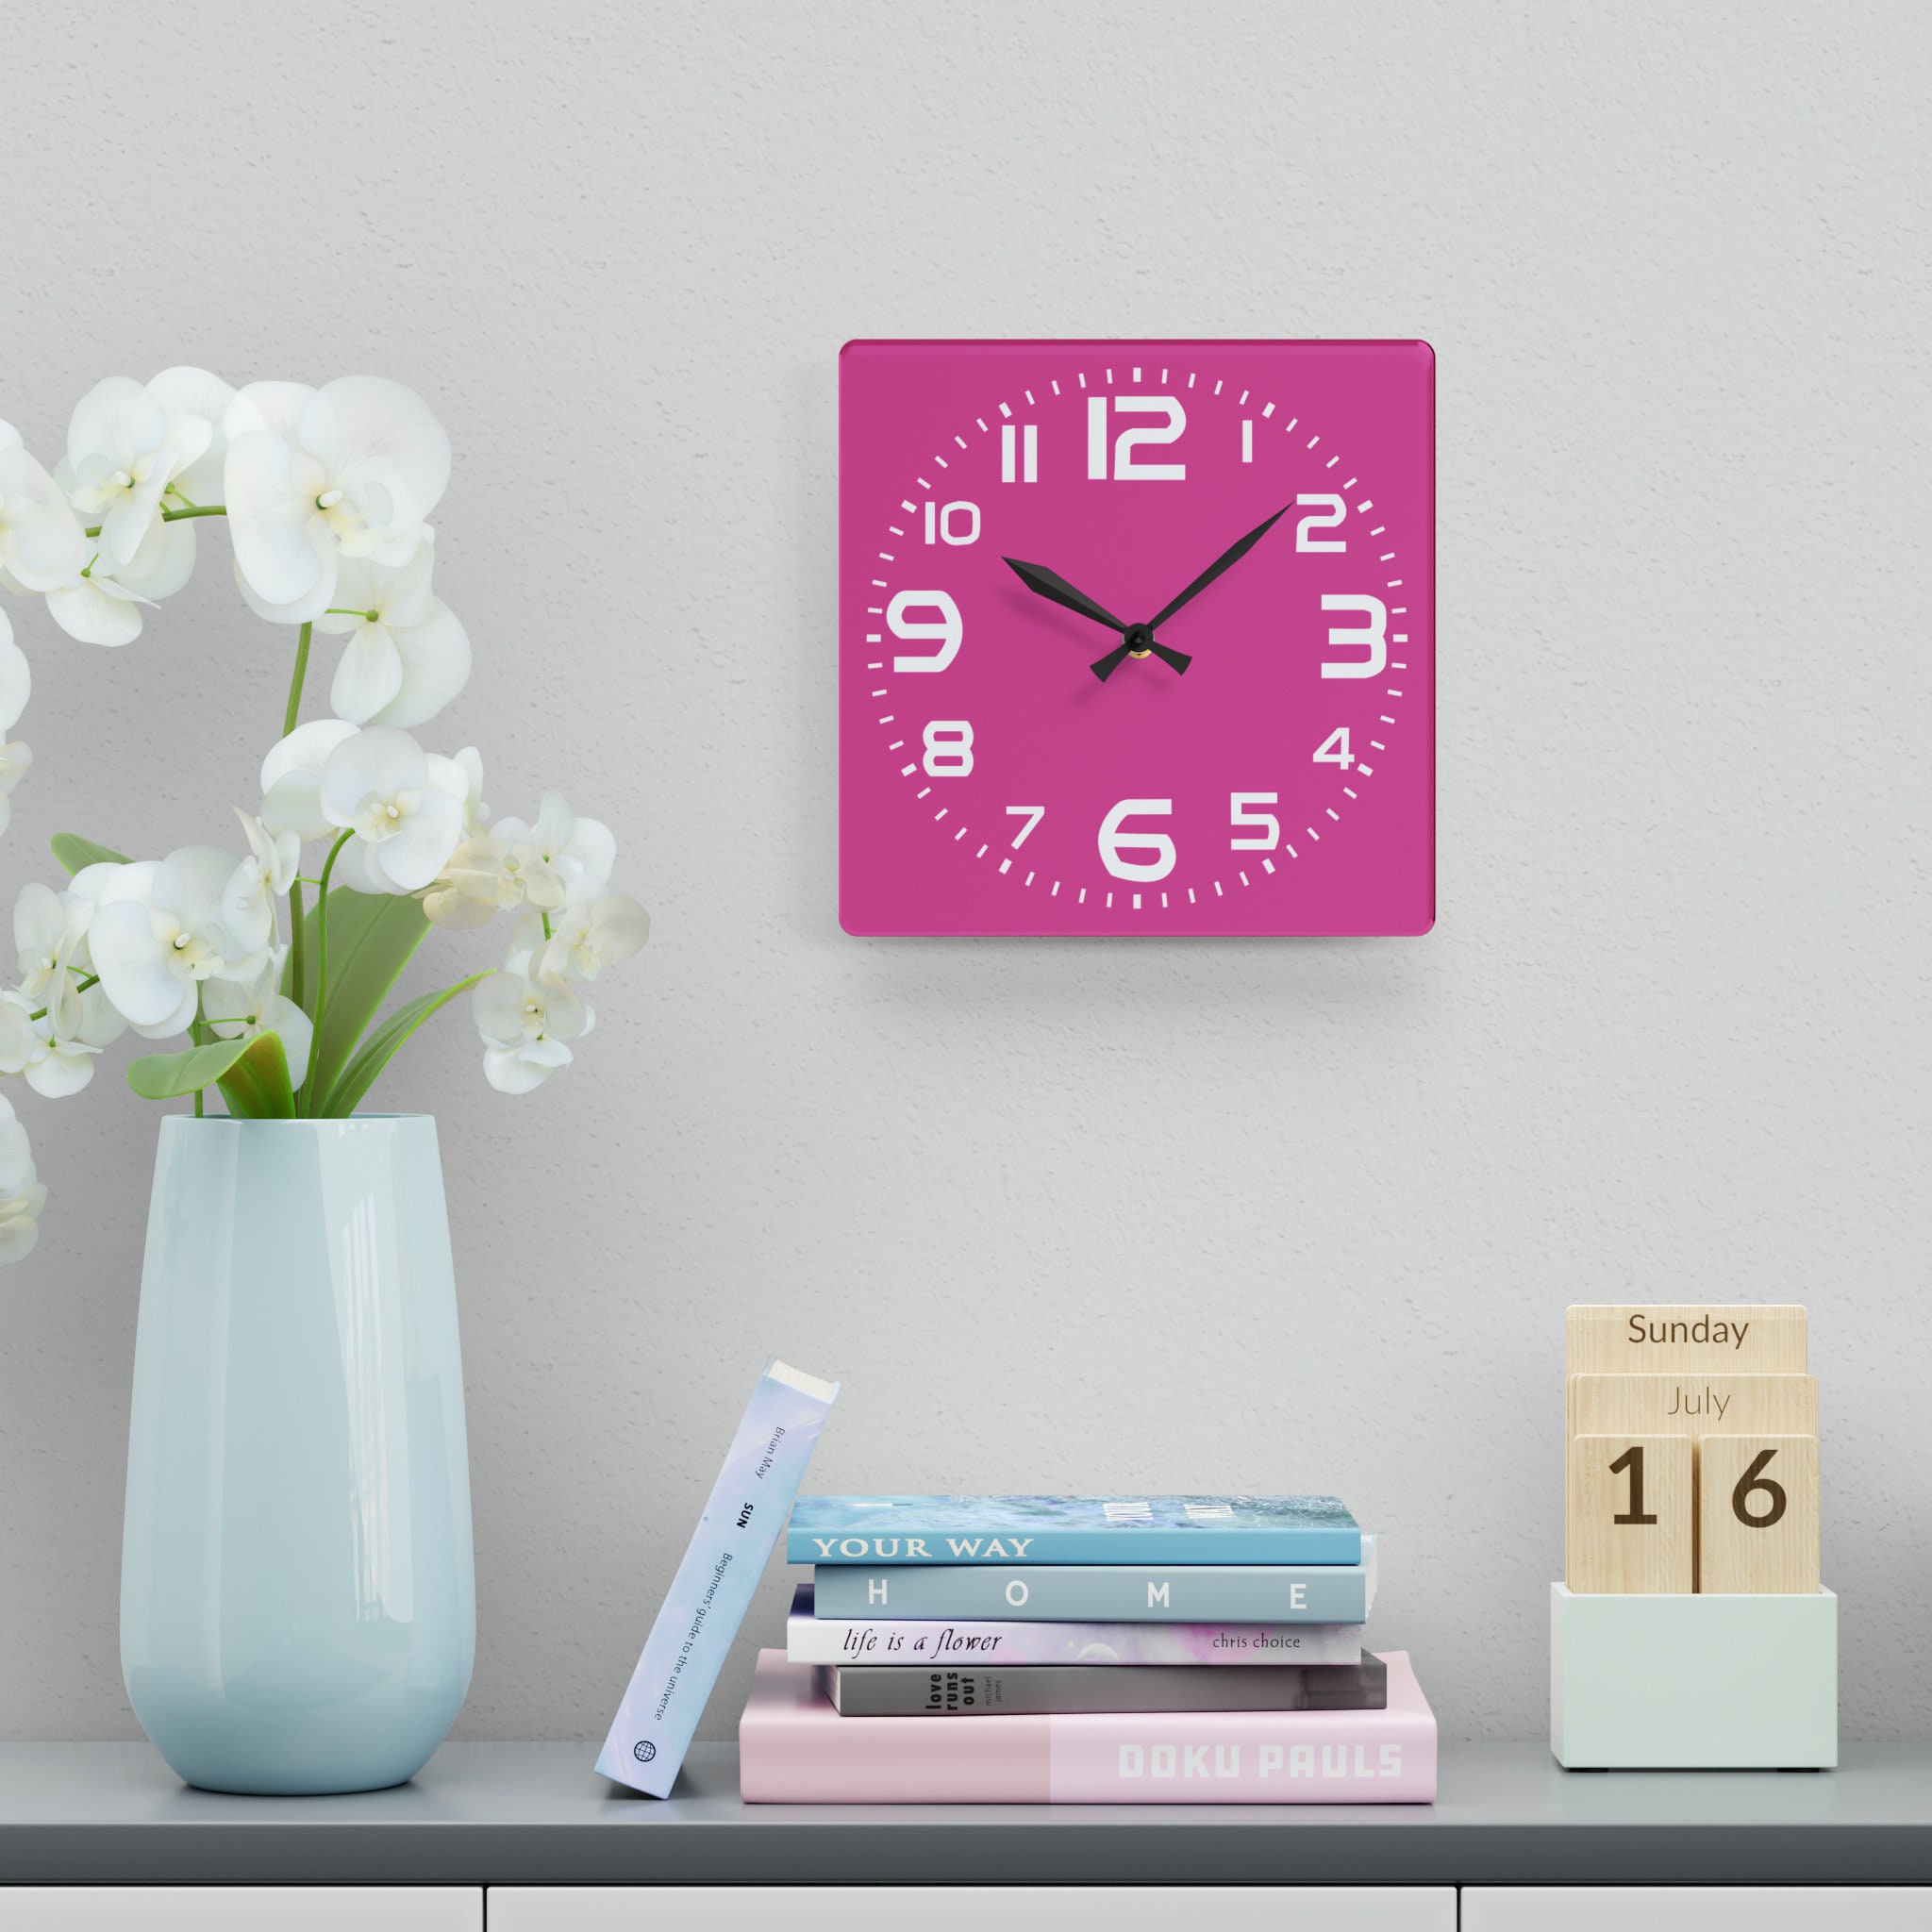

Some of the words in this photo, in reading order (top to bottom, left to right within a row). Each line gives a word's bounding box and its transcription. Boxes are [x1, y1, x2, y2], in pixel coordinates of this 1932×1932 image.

[1001, 425, 1038, 483] 11
[1087, 395, 1187, 481] 12
[1242, 420, 1253, 463] 1
[924, 500, 981, 546] 10
[1295, 493, 1348, 553] 2
[886, 590, 963, 673] 9
[1321, 594, 1388, 678] 3
[922, 720, 974, 777] 8
[1312, 726, 1356, 771] 4
[1006, 806, 1045, 850] 7
[1230, 791, 1280, 851] 5
[1097, 798, 1176, 883] 6
[1627, 1313, 1750, 1350] Sunday
[1667, 1386, 1731, 1422] July
[767, 1426, 786, 1455] Brian
[755, 1457, 774, 1479] May
[737, 1502, 754, 1528] SUN
[811, 1538, 933, 1557] YOUR
[945, 1538, 1034, 1557] WAY
[688, 1608, 707, 1640] guide
[1212, 1633, 1247, 1648] chris
[1253, 1633, 1301, 1648] choice
[682, 1641, 693, 1653] to
[843, 1628, 877, 1659] life
[887, 1632, 904, 1651] is
[913, 1636, 928, 1651] a
[929, 1628, 1003, 1659] flower
[673, 1656, 688, 1674] the
[654, 1675, 678, 1721] universe
[925, 1674, 941, 1709] love
[946, 1673, 958, 1710] runs
[960, 1677, 974, 1706] out
[984, 1676, 992, 1707] michael
[1119, 1744, 1240, 1778] DOKU
[1258, 1743, 1402, 1778] PAULS
